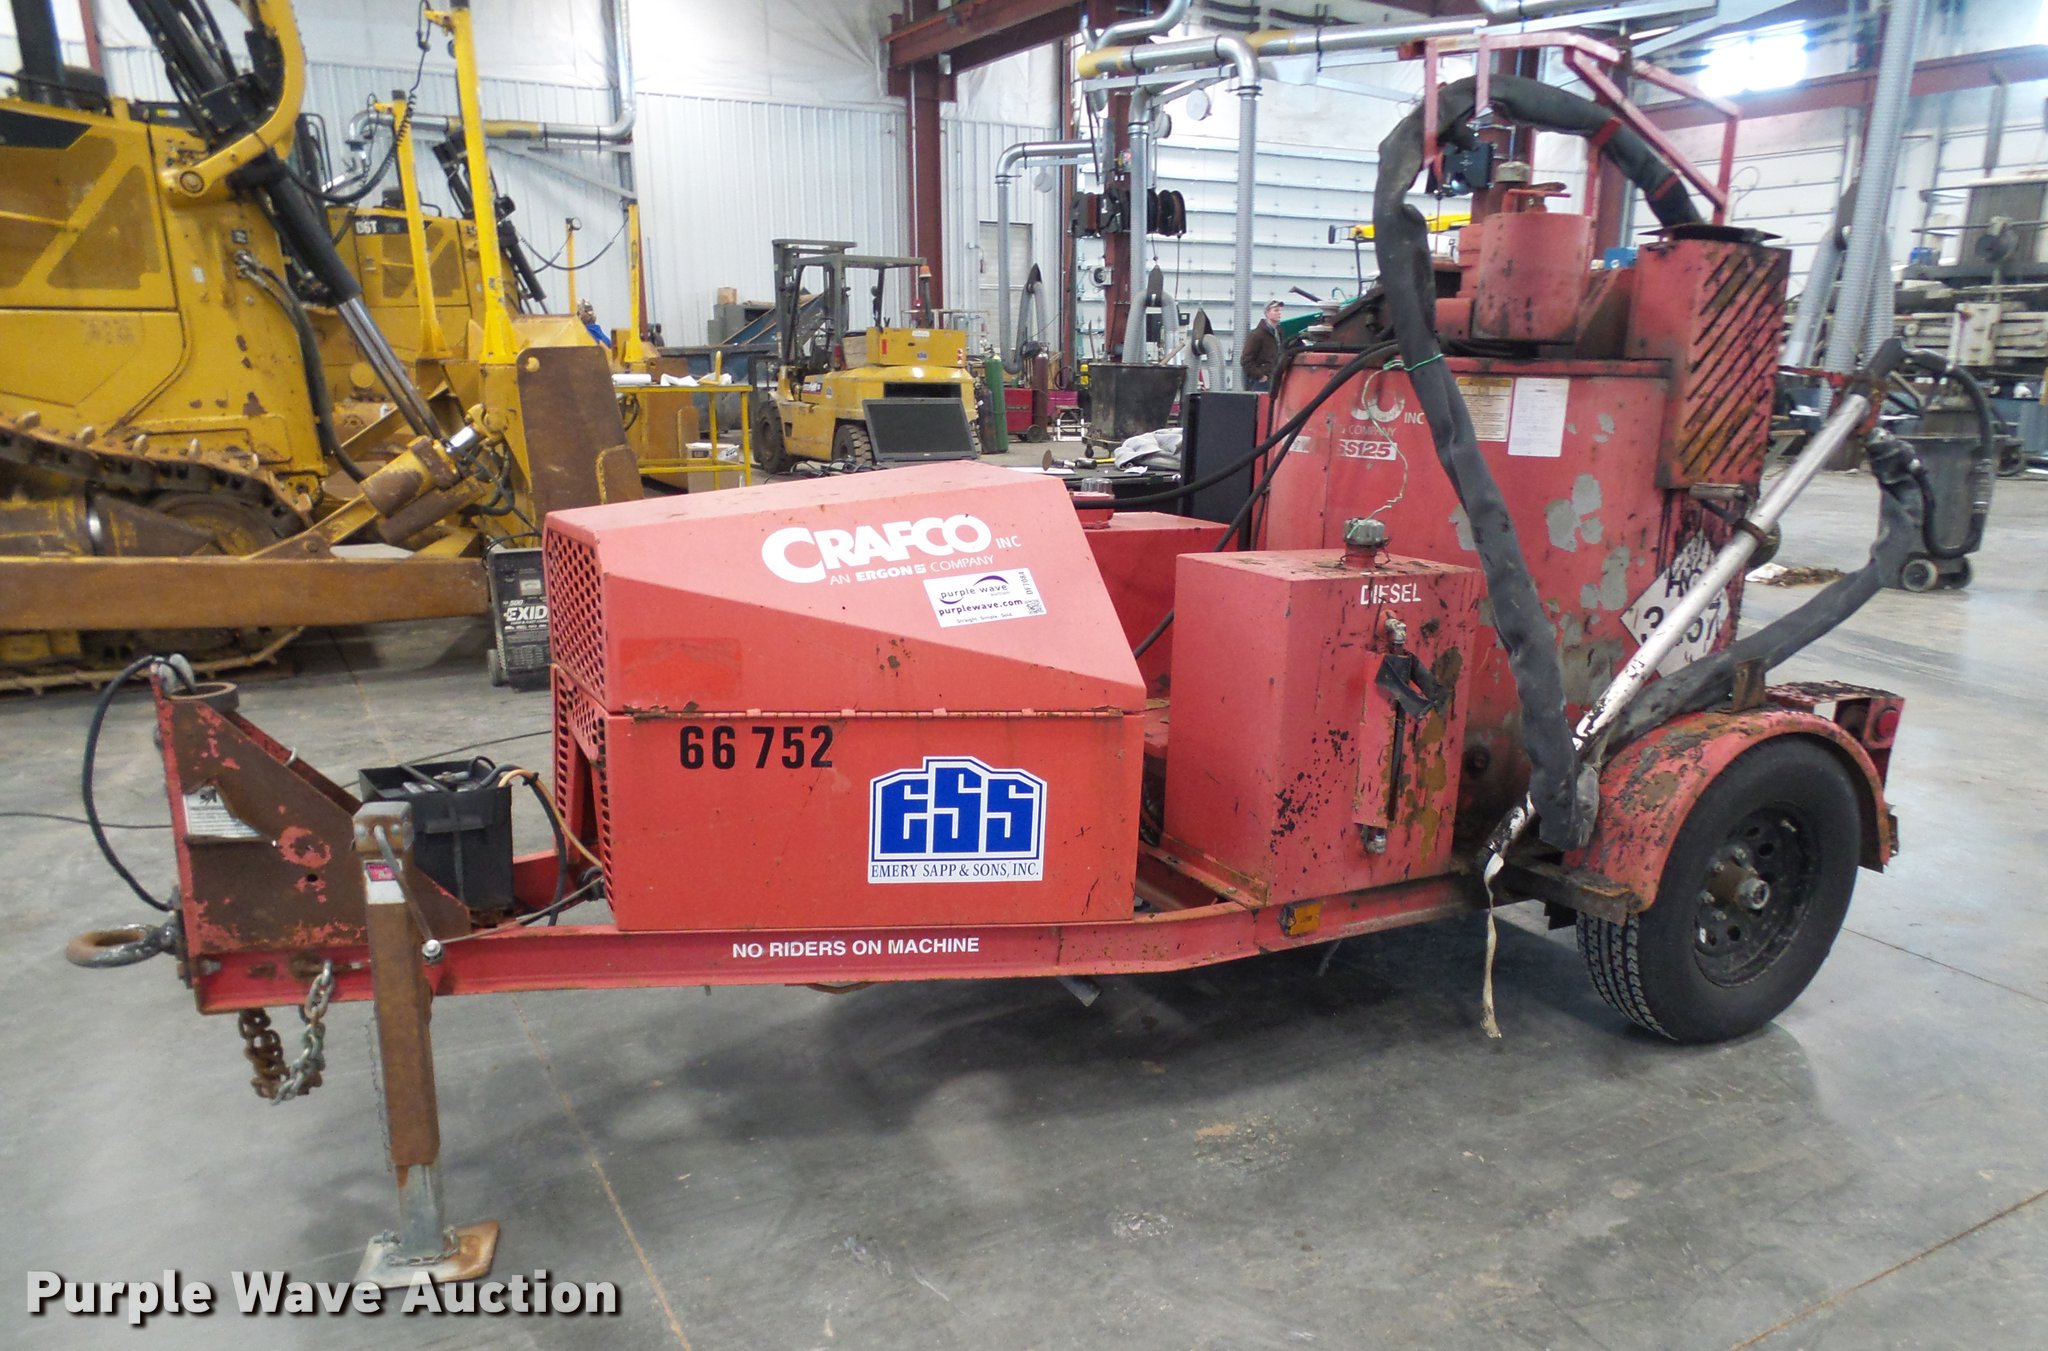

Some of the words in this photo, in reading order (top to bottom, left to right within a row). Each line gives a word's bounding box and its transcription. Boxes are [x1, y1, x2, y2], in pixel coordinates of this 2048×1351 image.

[1404, 412, 1425, 424] INC
[761, 514, 992, 583] CRAFCO
[995, 535, 1022, 550] INC
[829, 574, 851, 586] AN
[855, 567, 914, 582] ERGON
[930, 555, 994, 573] COMPANY
[940, 588, 976, 599] purple
[979, 584, 1008, 593] wave
[1360, 583, 1422, 605] DIESEL
[939, 599, 1023, 616] purplewave.com
[680, 726, 736, 769] 66
[752, 725, 833, 769] 752
[880, 767, 1034, 853] ESS
[872, 864, 917, 878] EMERY
[923, 864, 957, 878] SAPP
[959, 864, 969, 876] &
[973, 863, 1010, 878] SONS,
[1013, 862, 1039, 876] INC.
[732, 943, 763, 958] NO
[769, 941, 846, 957] RIDERS
[852, 940, 882, 955] ON
[888, 937, 980, 954] MACHINE
